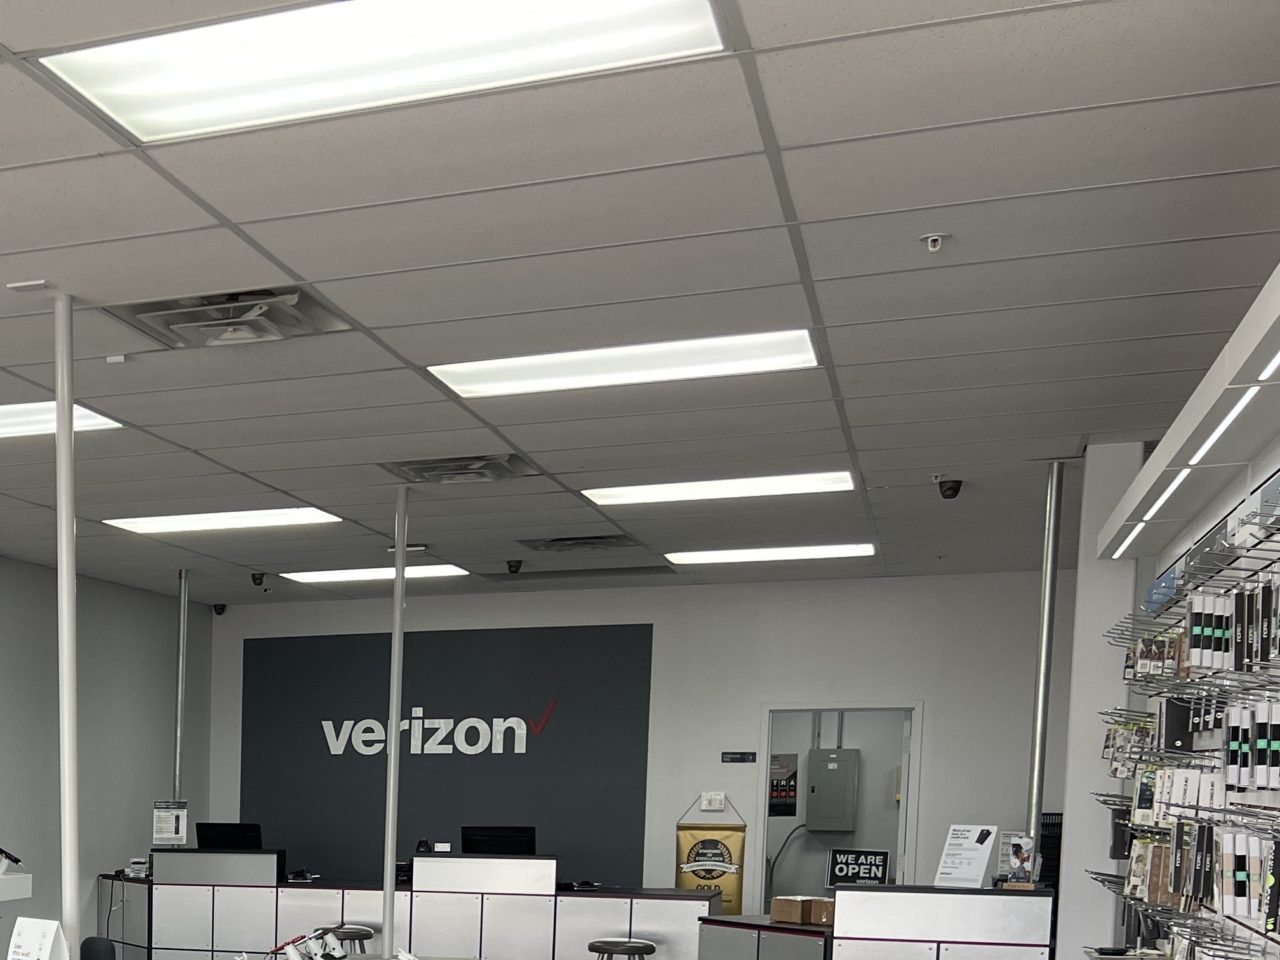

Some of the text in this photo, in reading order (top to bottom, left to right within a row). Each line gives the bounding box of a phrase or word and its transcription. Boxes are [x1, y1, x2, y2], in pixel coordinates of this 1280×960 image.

[836, 854, 884, 865] WE ARE
[834, 864, 883, 878] OPEN
